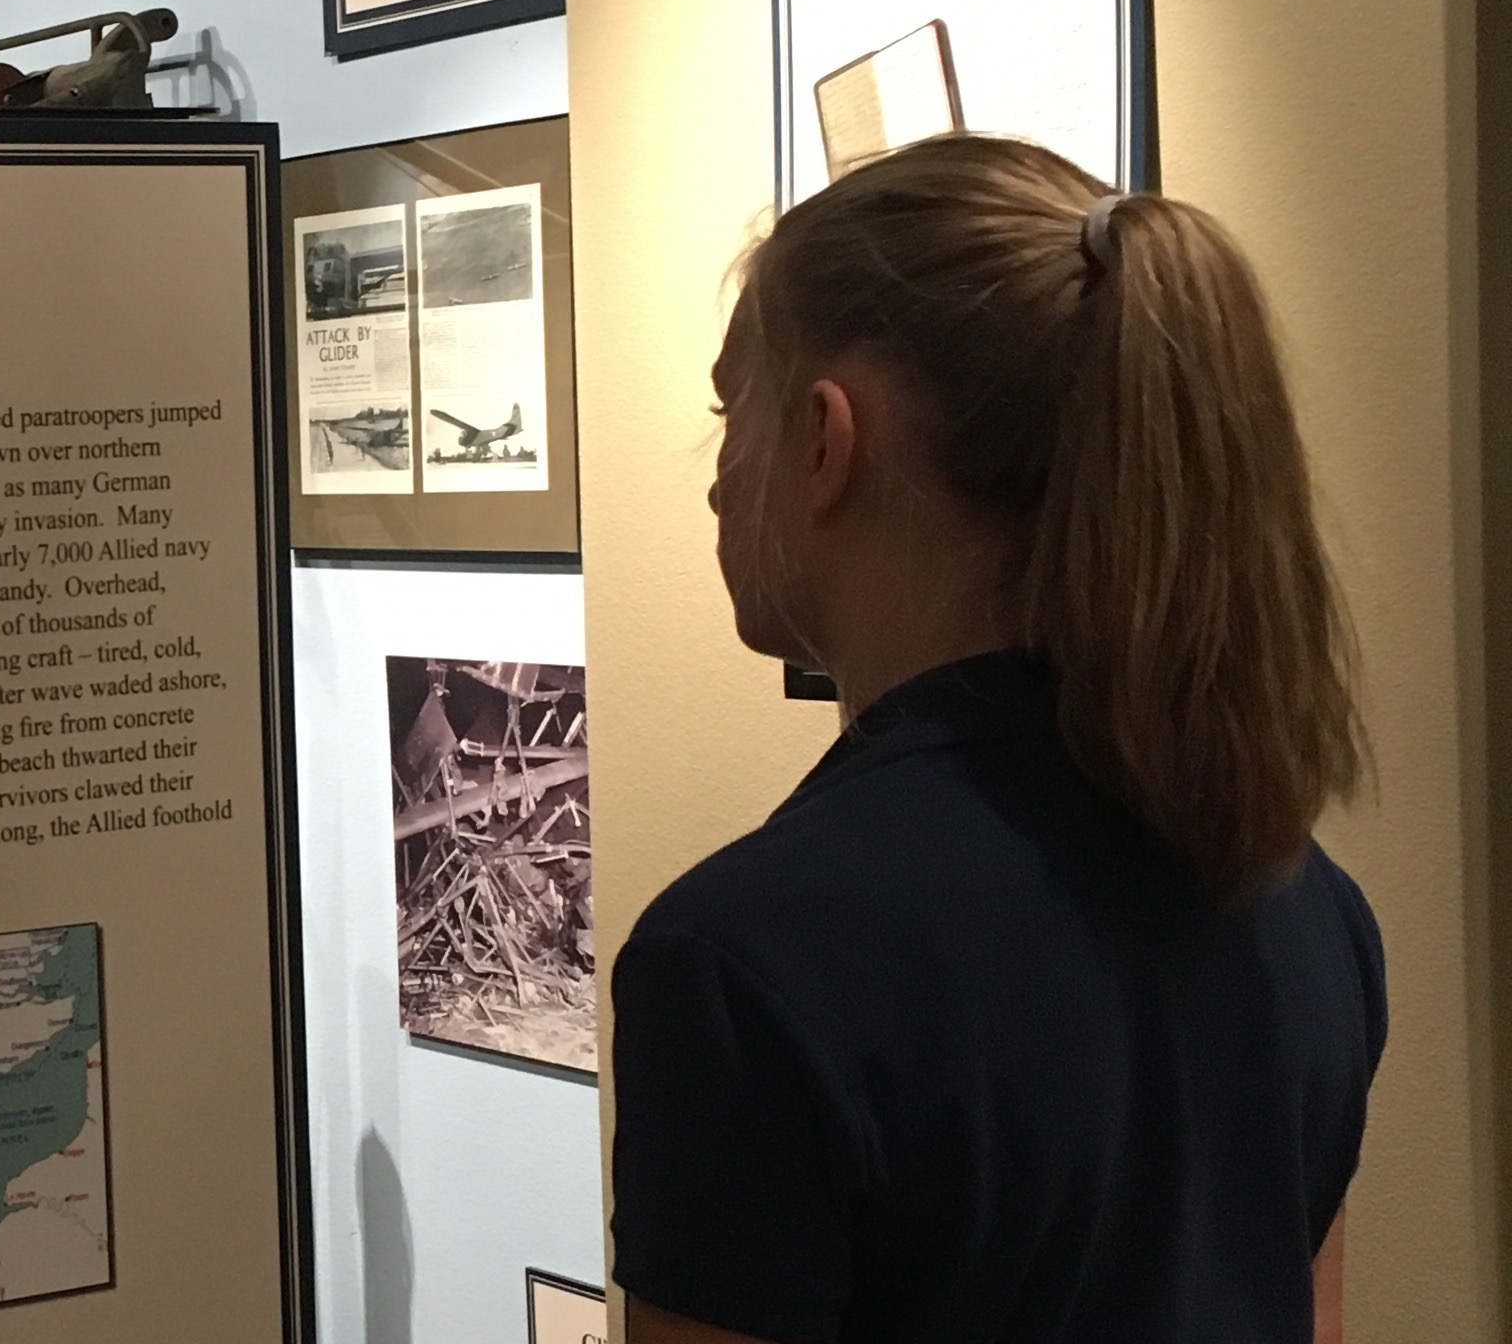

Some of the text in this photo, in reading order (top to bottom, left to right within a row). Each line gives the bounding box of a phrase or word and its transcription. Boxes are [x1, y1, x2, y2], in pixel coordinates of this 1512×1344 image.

[305, 325, 372, 346] ATTACK BY
[319, 344, 359, 362] GLIDER
[20, 408, 144, 434] paratroopers
[147, 399, 222, 429] jumped
[27, 445, 73, 462] over
[78, 436, 161, 460] northern
[4, 481, 25, 498] as
[31, 479, 86, 500] many
[92, 471, 171, 494] German
[14, 507, 104, 532] invasion.
[117, 504, 172, 530] Many
[50, 815, 81, 837] the
[86, 807, 147, 834] Allied
[152, 798, 233, 827] foothold
